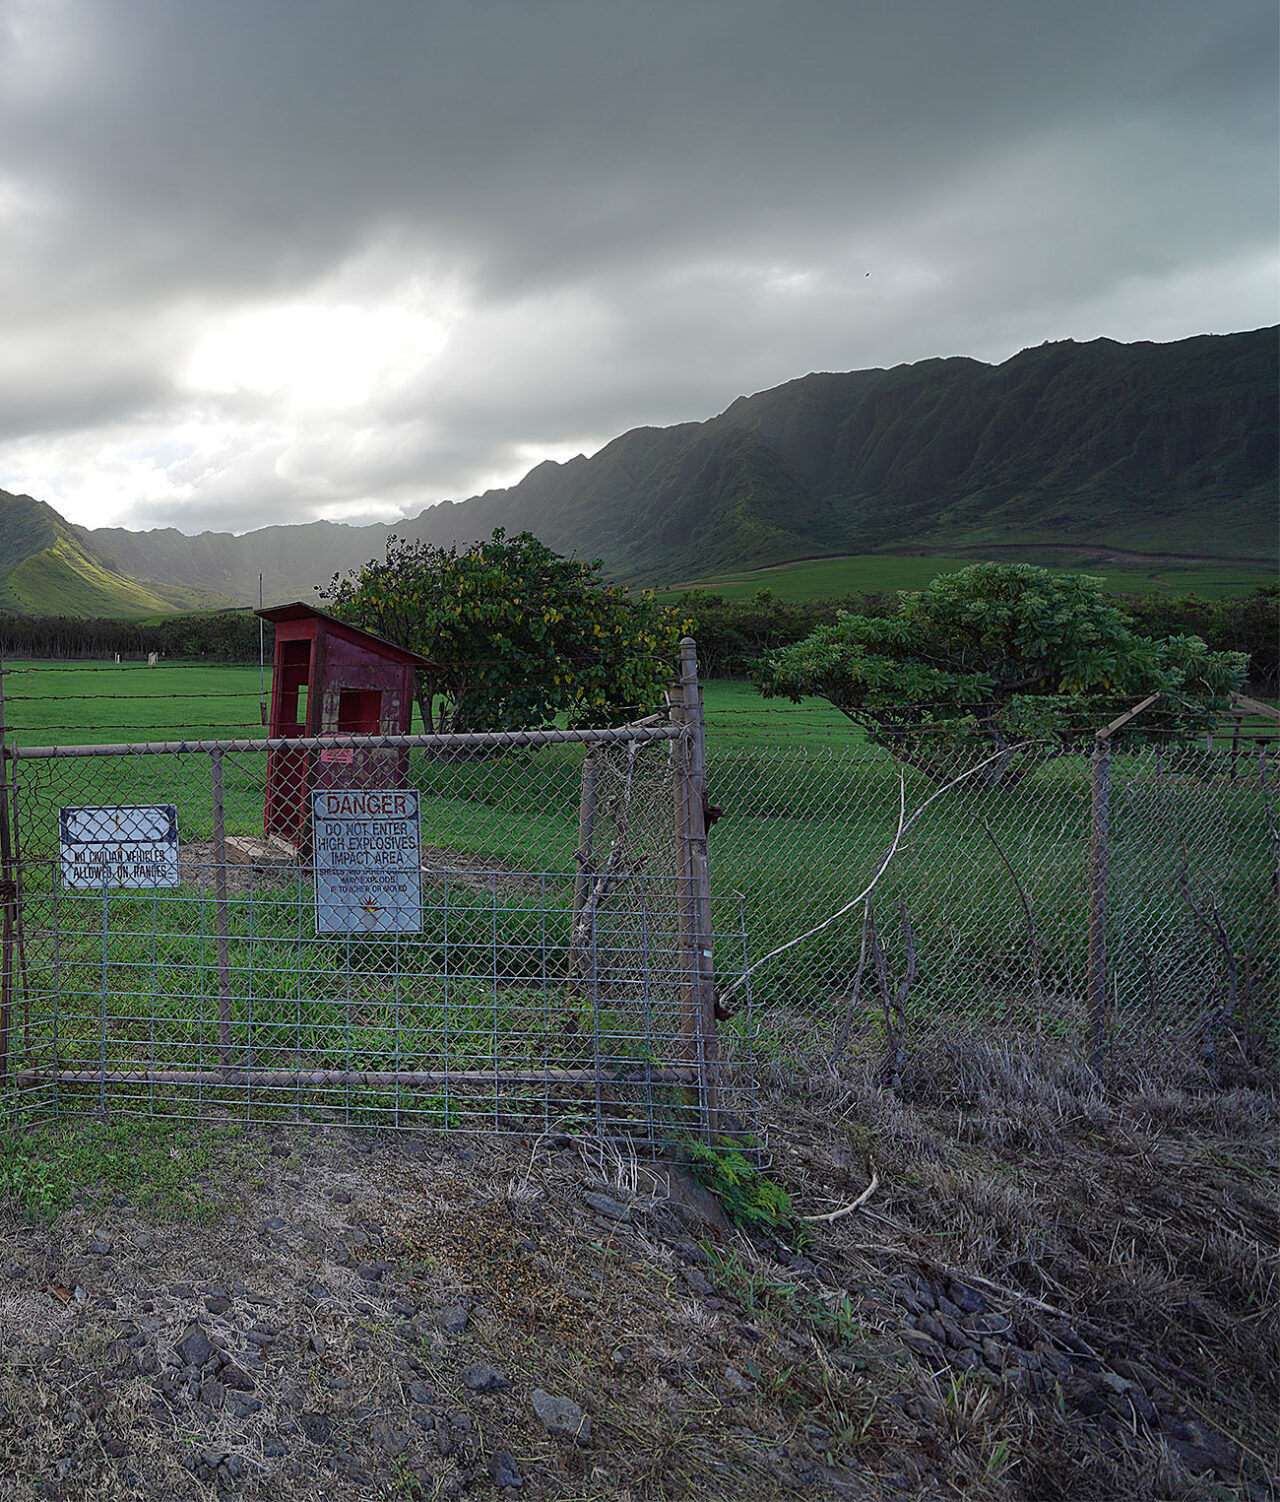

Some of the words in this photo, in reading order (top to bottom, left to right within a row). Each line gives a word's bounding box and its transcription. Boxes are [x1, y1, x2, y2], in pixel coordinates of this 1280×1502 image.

[327, 795, 406, 814] DANGER
[325, 823, 341, 836] DO
[346, 823, 367, 836] NOT
[372, 822, 408, 835] ENTER
[319, 837, 345, 851] HIGH
[349, 836, 416, 850] EXPLOSIVES
[126, 850, 165, 862] VEHICLES
[332, 852, 370, 865] IMPACT
[375, 851, 404, 864] AREA
[73, 865, 112, 879] ALLOWED
[117, 865, 129, 878] ON
